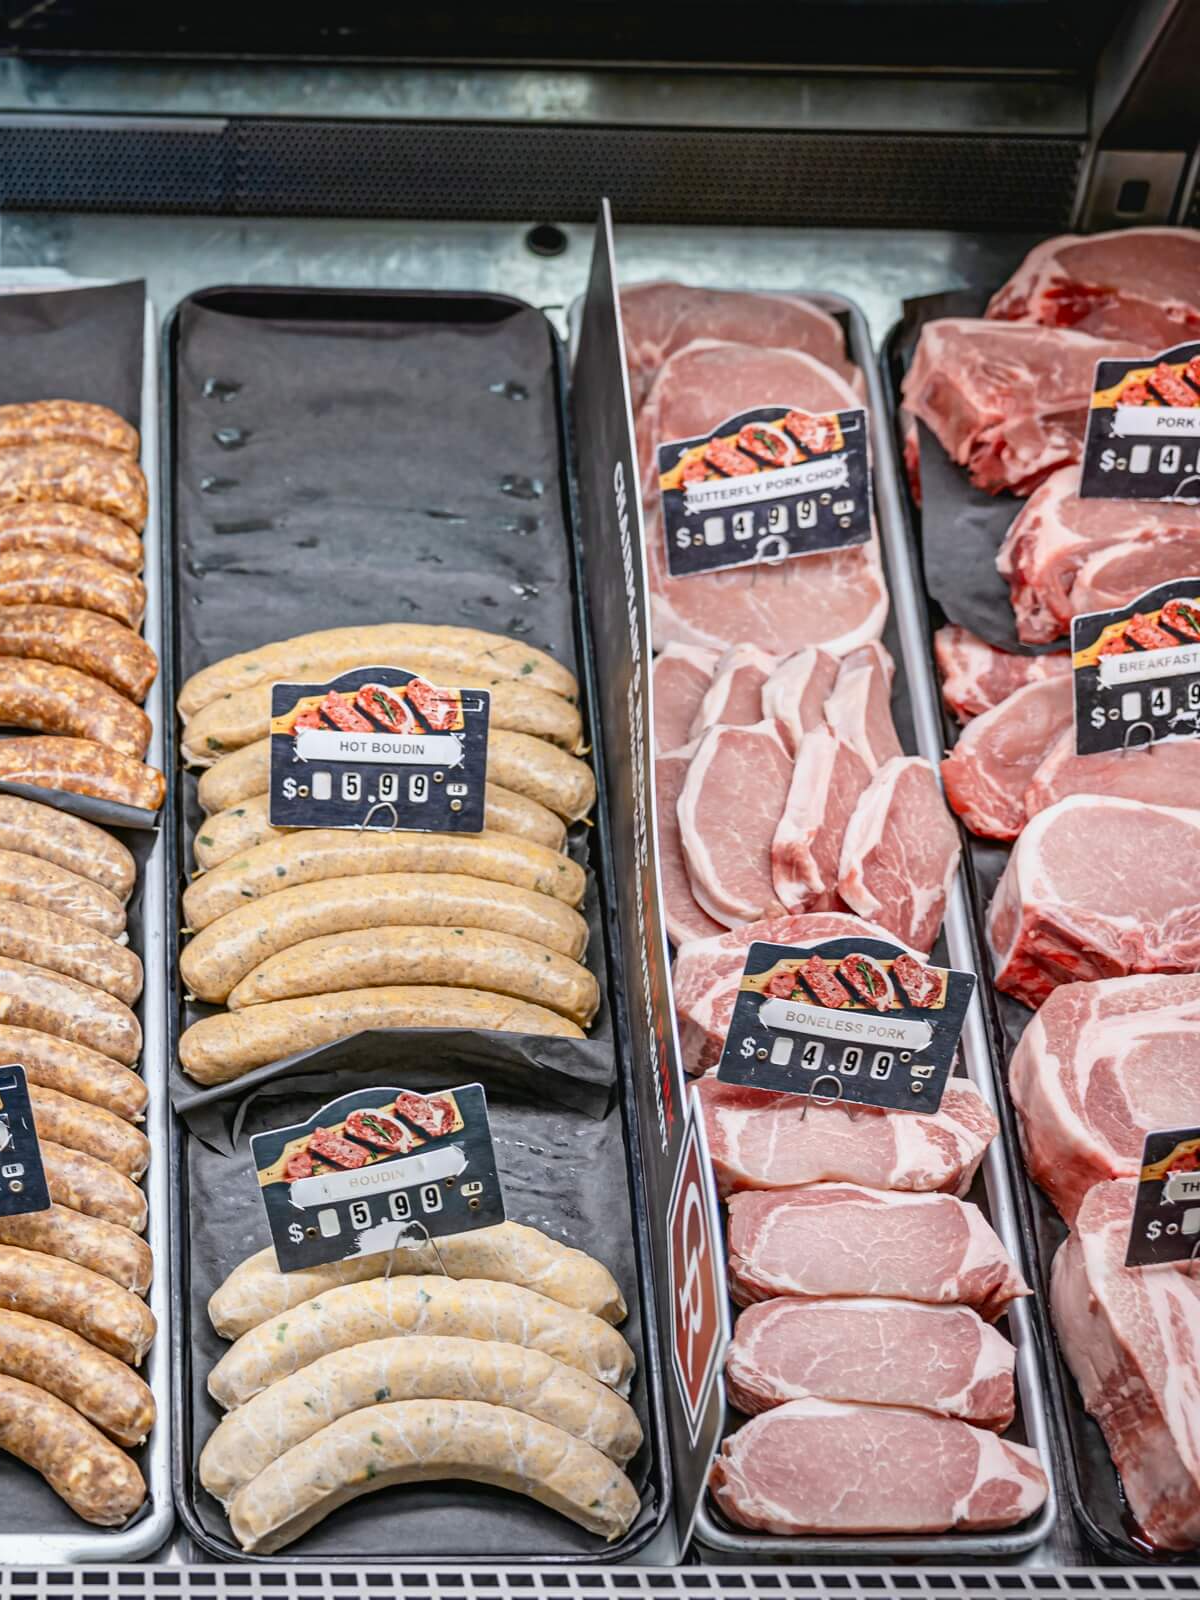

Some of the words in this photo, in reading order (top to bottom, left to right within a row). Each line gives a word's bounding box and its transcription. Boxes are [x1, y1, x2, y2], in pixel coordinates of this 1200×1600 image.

[1157, 417, 1194, 428] PORK
[766, 477, 802, 491] PORK
[806, 468, 843, 484] CHOP
[1119, 653, 1198, 673] BREAKFAST
[340, 742, 367, 752] HOT
[372, 742, 425, 755] BOUDIN
[786, 1011, 863, 1033] BONELESS
[867, 1025, 905, 1041] PORK
[350, 1171, 405, 1188] BOUDIN
